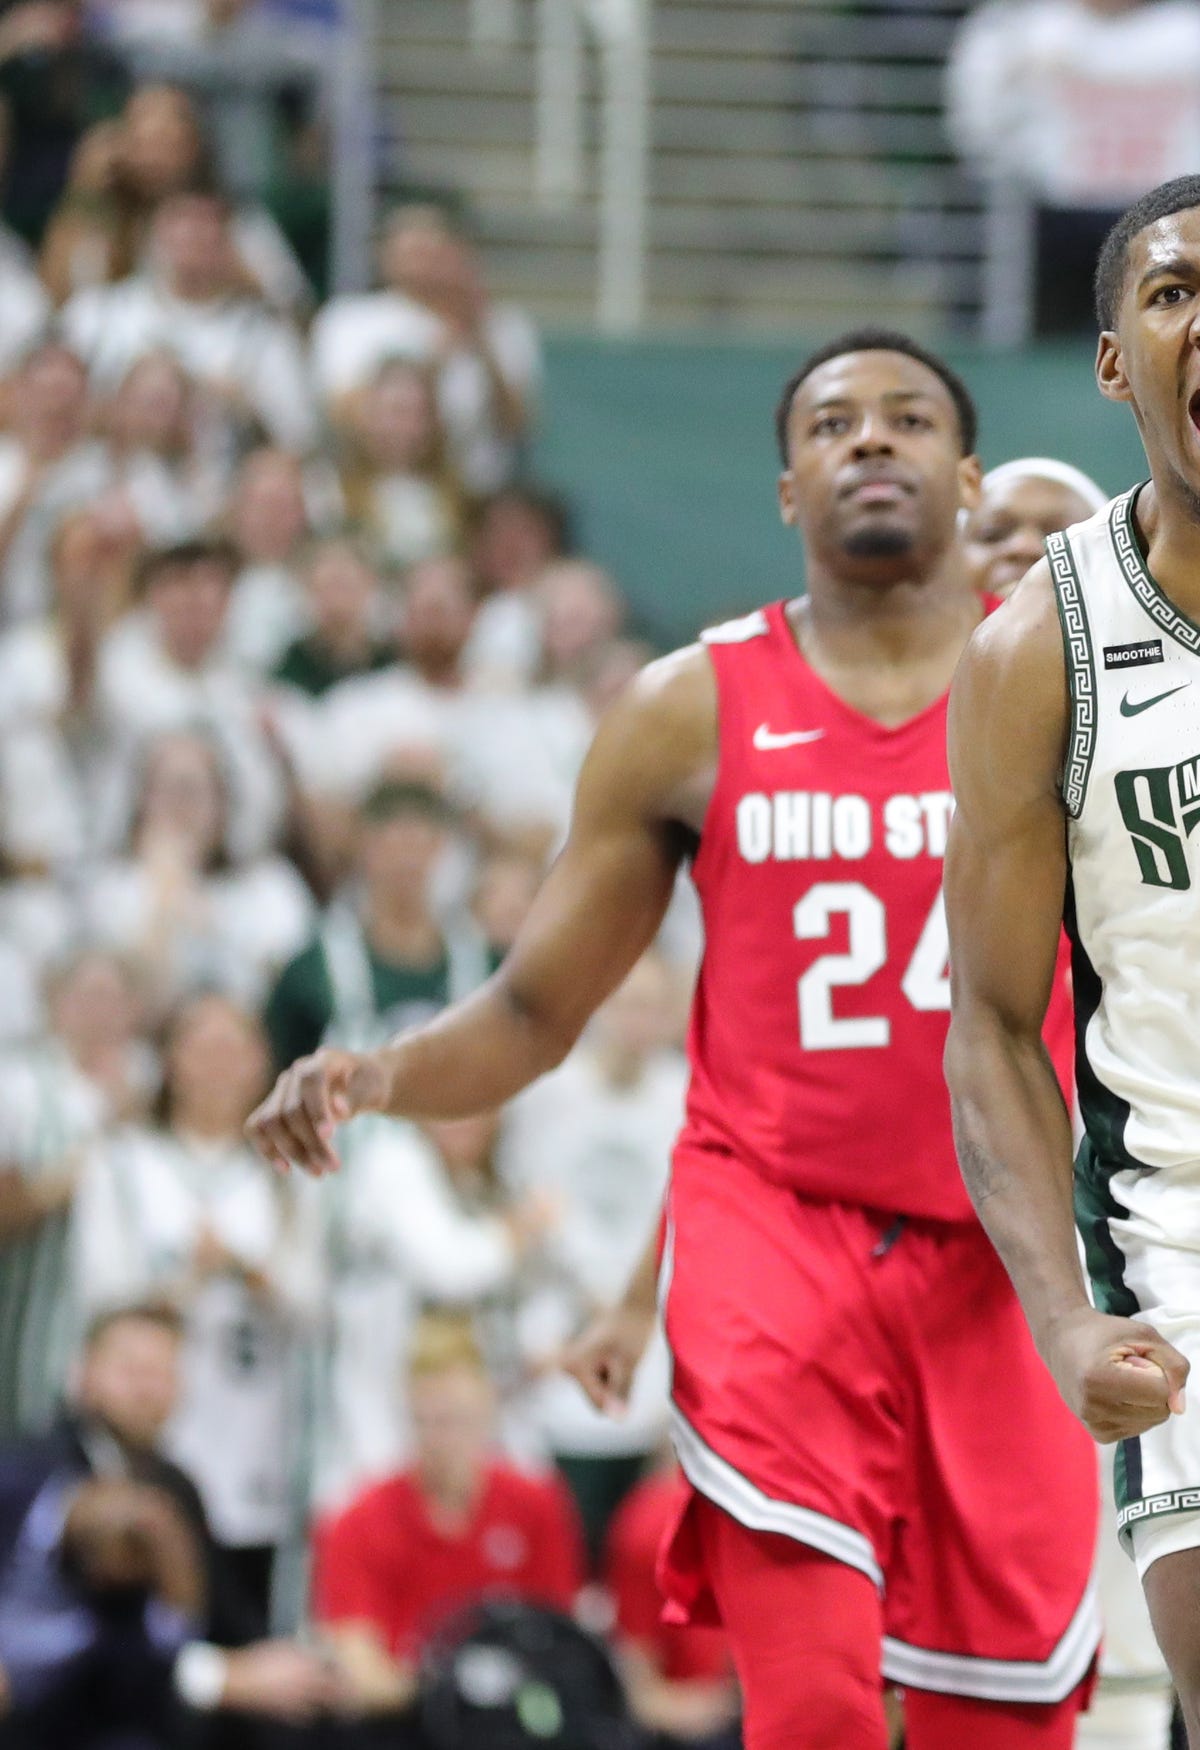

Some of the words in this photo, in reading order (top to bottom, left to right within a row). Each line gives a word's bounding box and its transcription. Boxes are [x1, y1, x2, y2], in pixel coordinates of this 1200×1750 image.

[1106, 646, 1161, 663] SMOOTHIE
[736, 790, 871, 864] OHIO
[884, 790, 957, 860] ST
